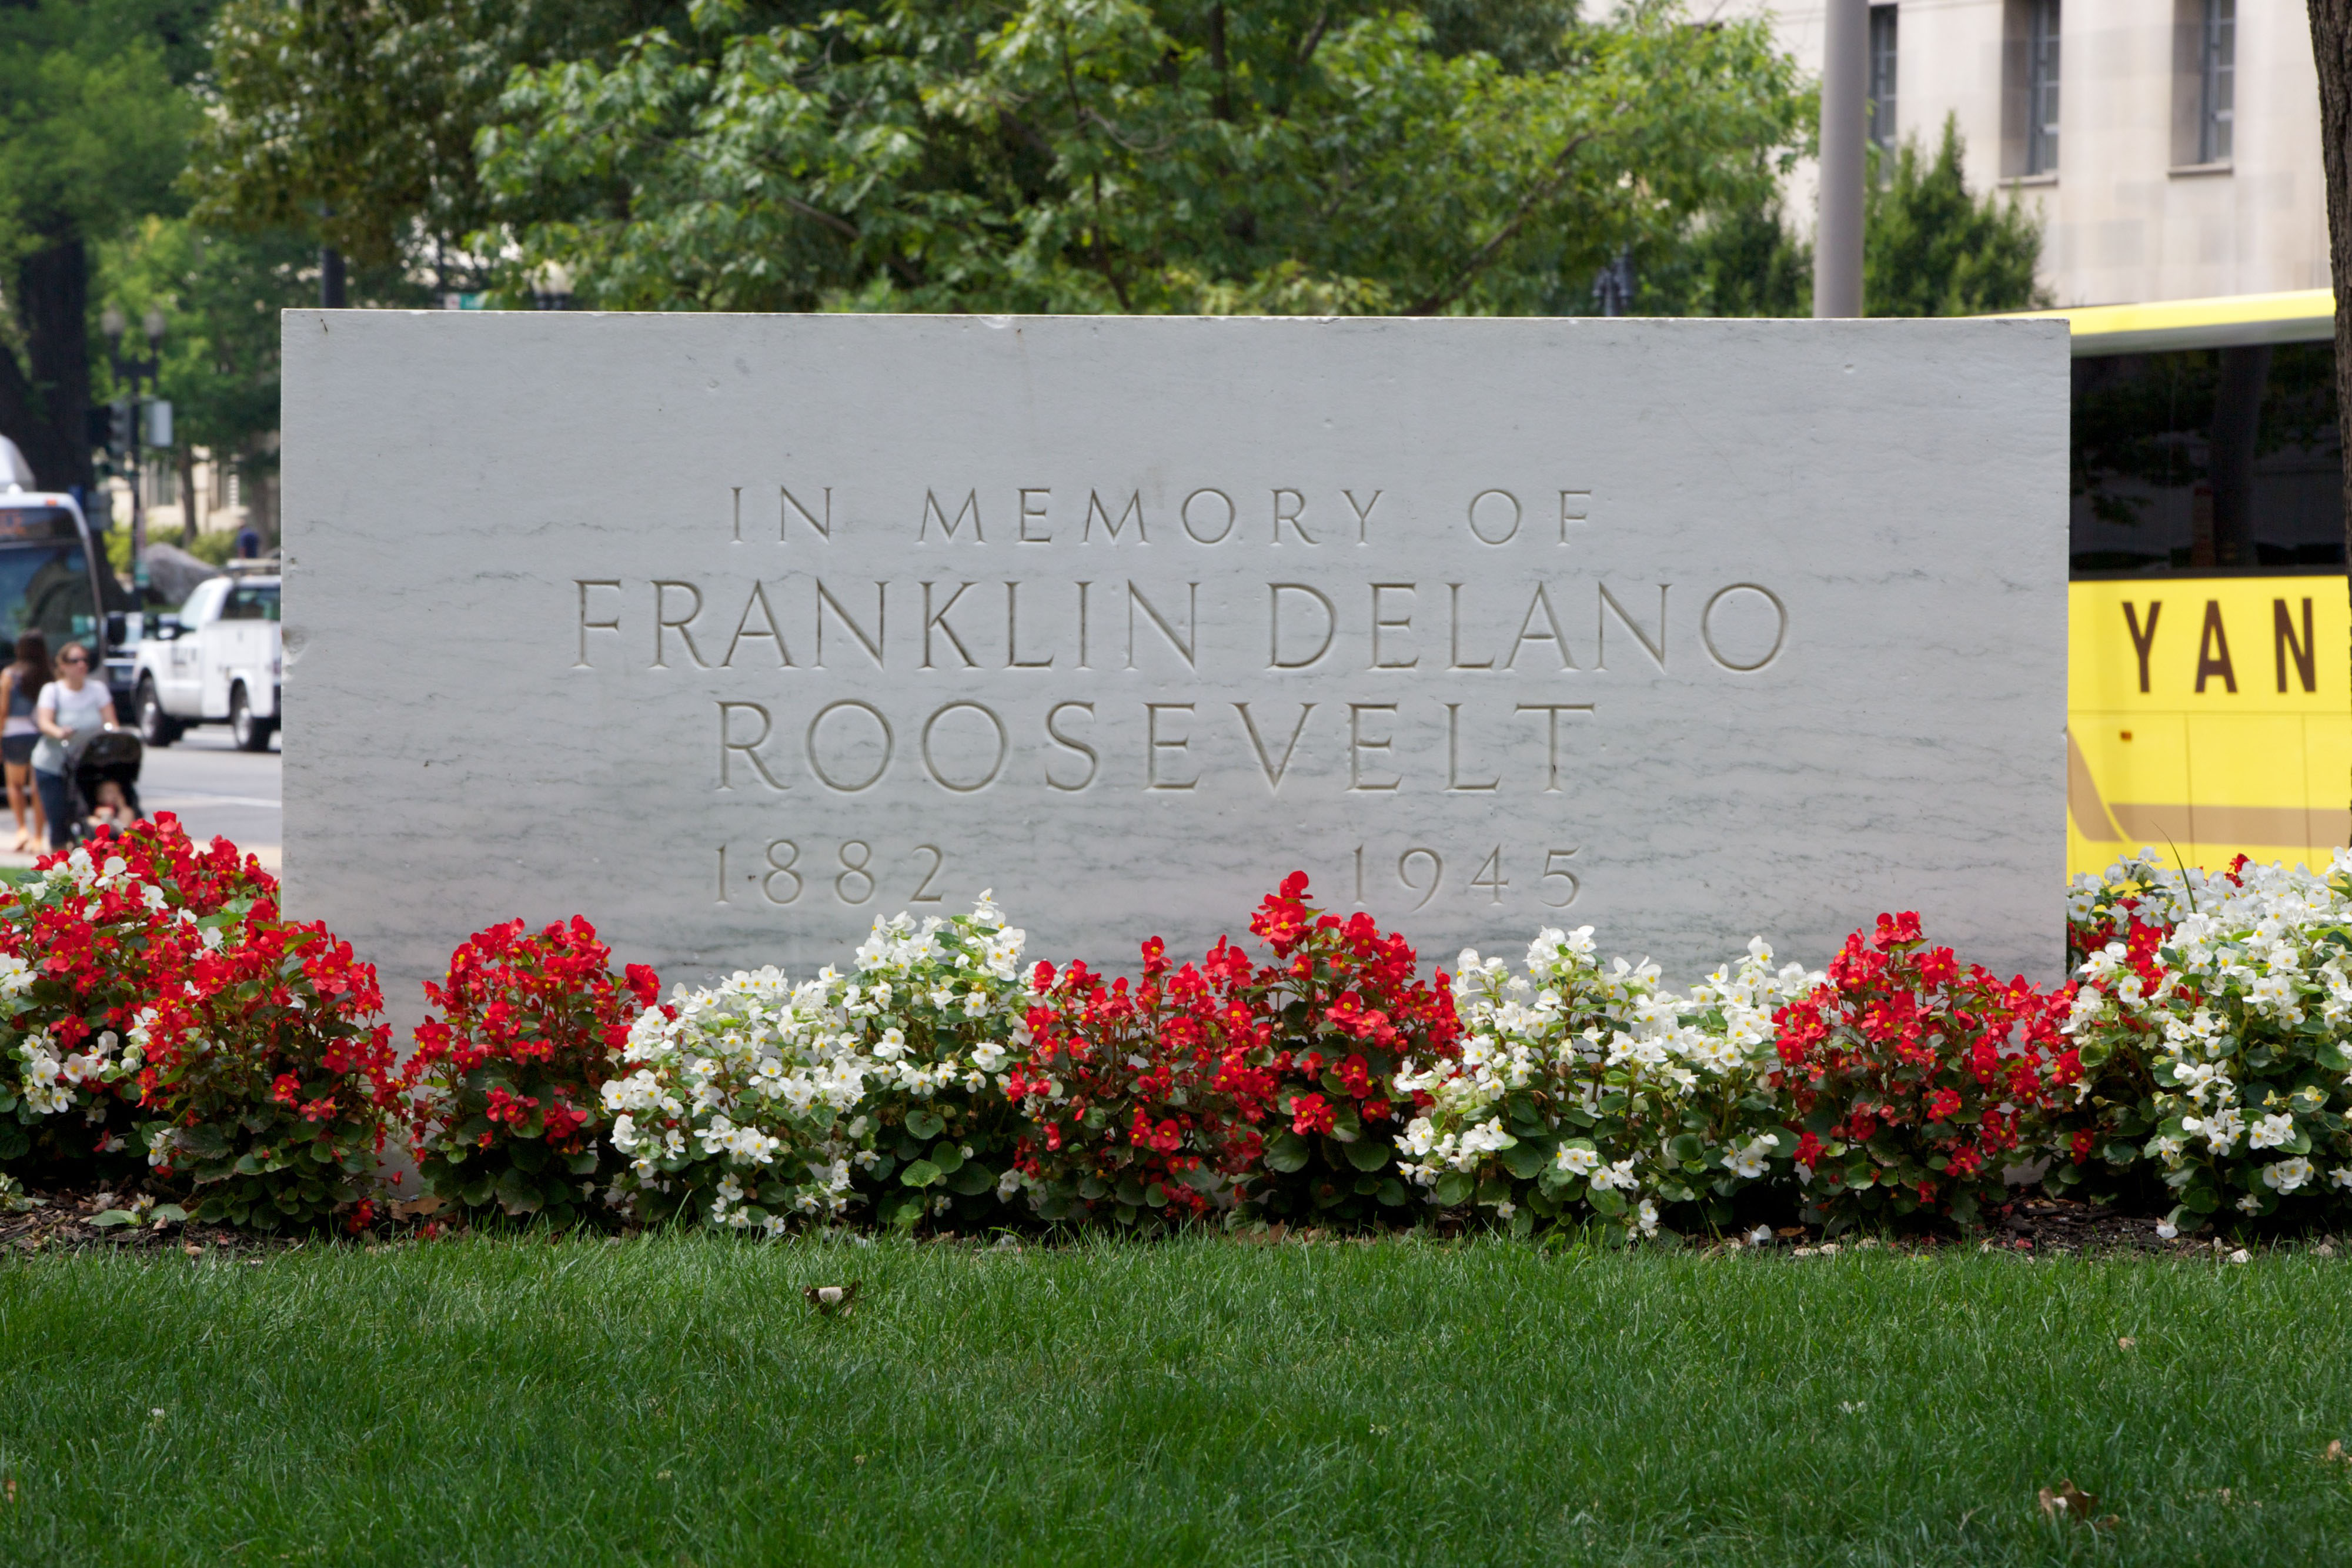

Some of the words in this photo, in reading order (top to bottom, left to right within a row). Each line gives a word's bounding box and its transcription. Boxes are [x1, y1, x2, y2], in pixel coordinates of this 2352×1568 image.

[731, 486, 833, 543] IN
[915, 487, 1384, 546] MEMORY
[1469, 488, 1592, 546] OF
[572, 578, 1200, 670] FRANKLIN
[1265, 581, 1789, 673] DELANO
[2122, 597, 2317, 694] YAN
[716, 700, 1595, 793] ROOSEVELT
[714, 839, 943, 905] 1882
[1352, 844, 1582, 911] 1945
